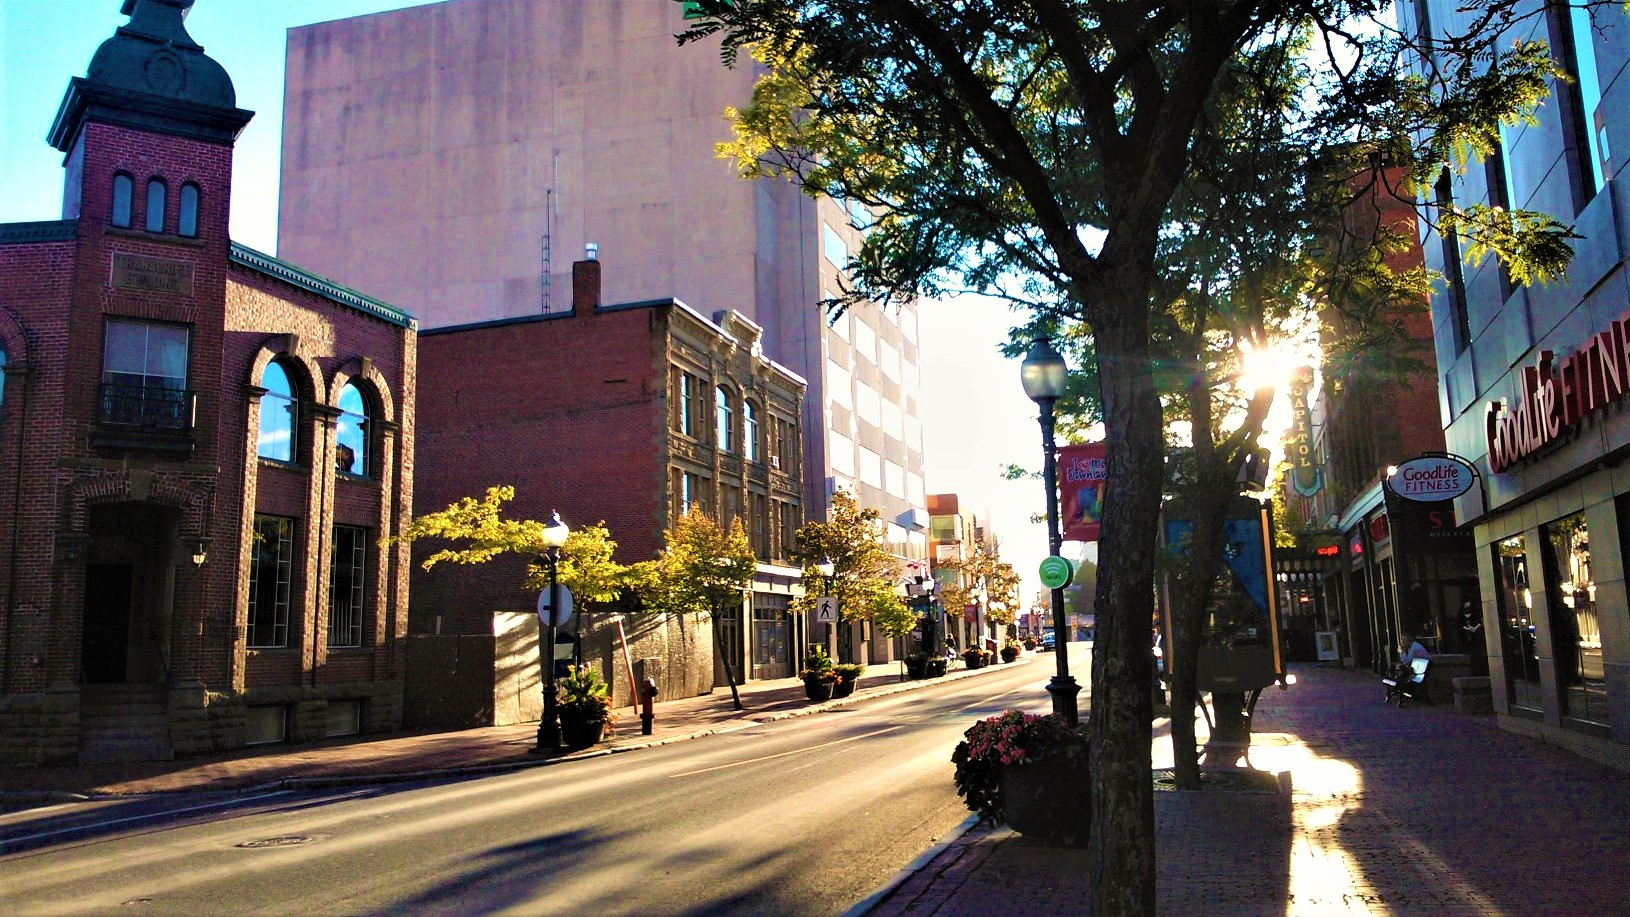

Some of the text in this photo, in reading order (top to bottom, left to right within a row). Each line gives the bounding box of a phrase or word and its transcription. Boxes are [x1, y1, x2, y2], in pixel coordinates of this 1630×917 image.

[1292, 386, 1310, 467] CAPITOL
[1485, 349, 1559, 475] GoodLife
[1403, 465, 1458, 481] GoodLife
[1405, 479, 1459, 492] FITNESS
